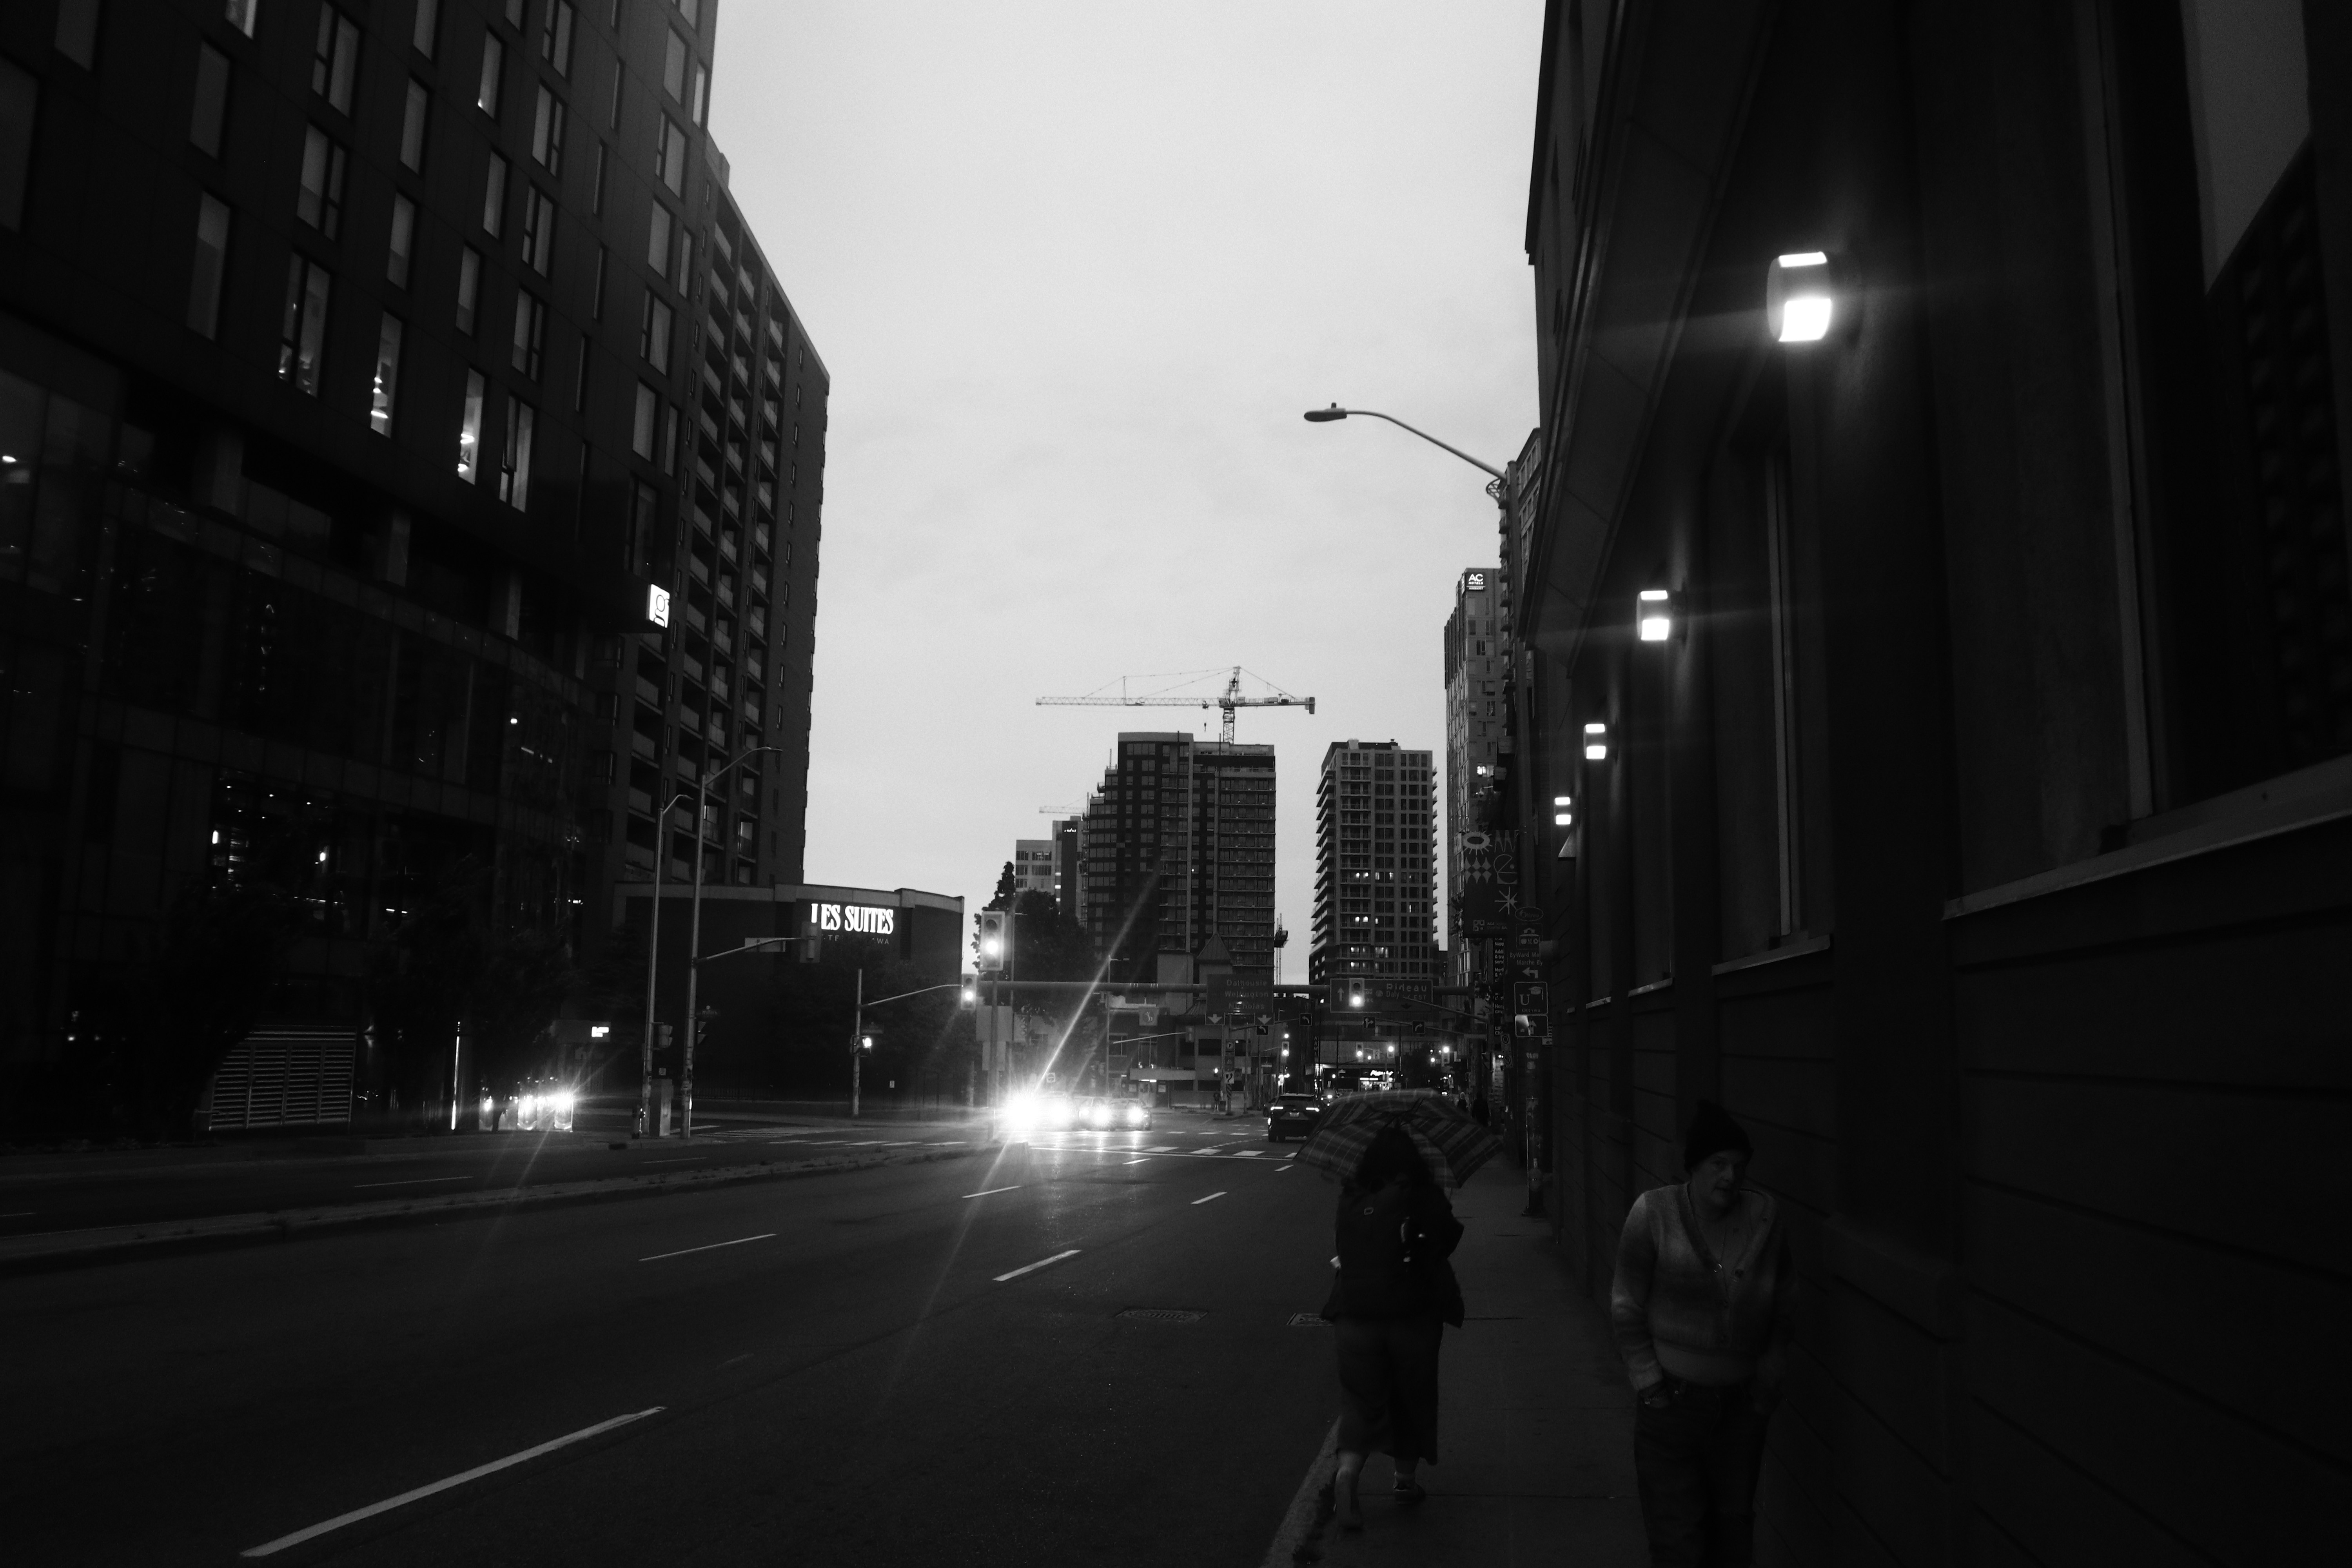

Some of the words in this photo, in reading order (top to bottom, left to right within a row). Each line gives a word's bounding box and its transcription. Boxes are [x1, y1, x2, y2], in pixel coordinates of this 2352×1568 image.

[1468, 573, 1483, 582] AC
[844, 906, 894, 935] SUITES
[1386, 983, 1427, 992] Rideau
[1386, 990, 1399, 1000] Daly
